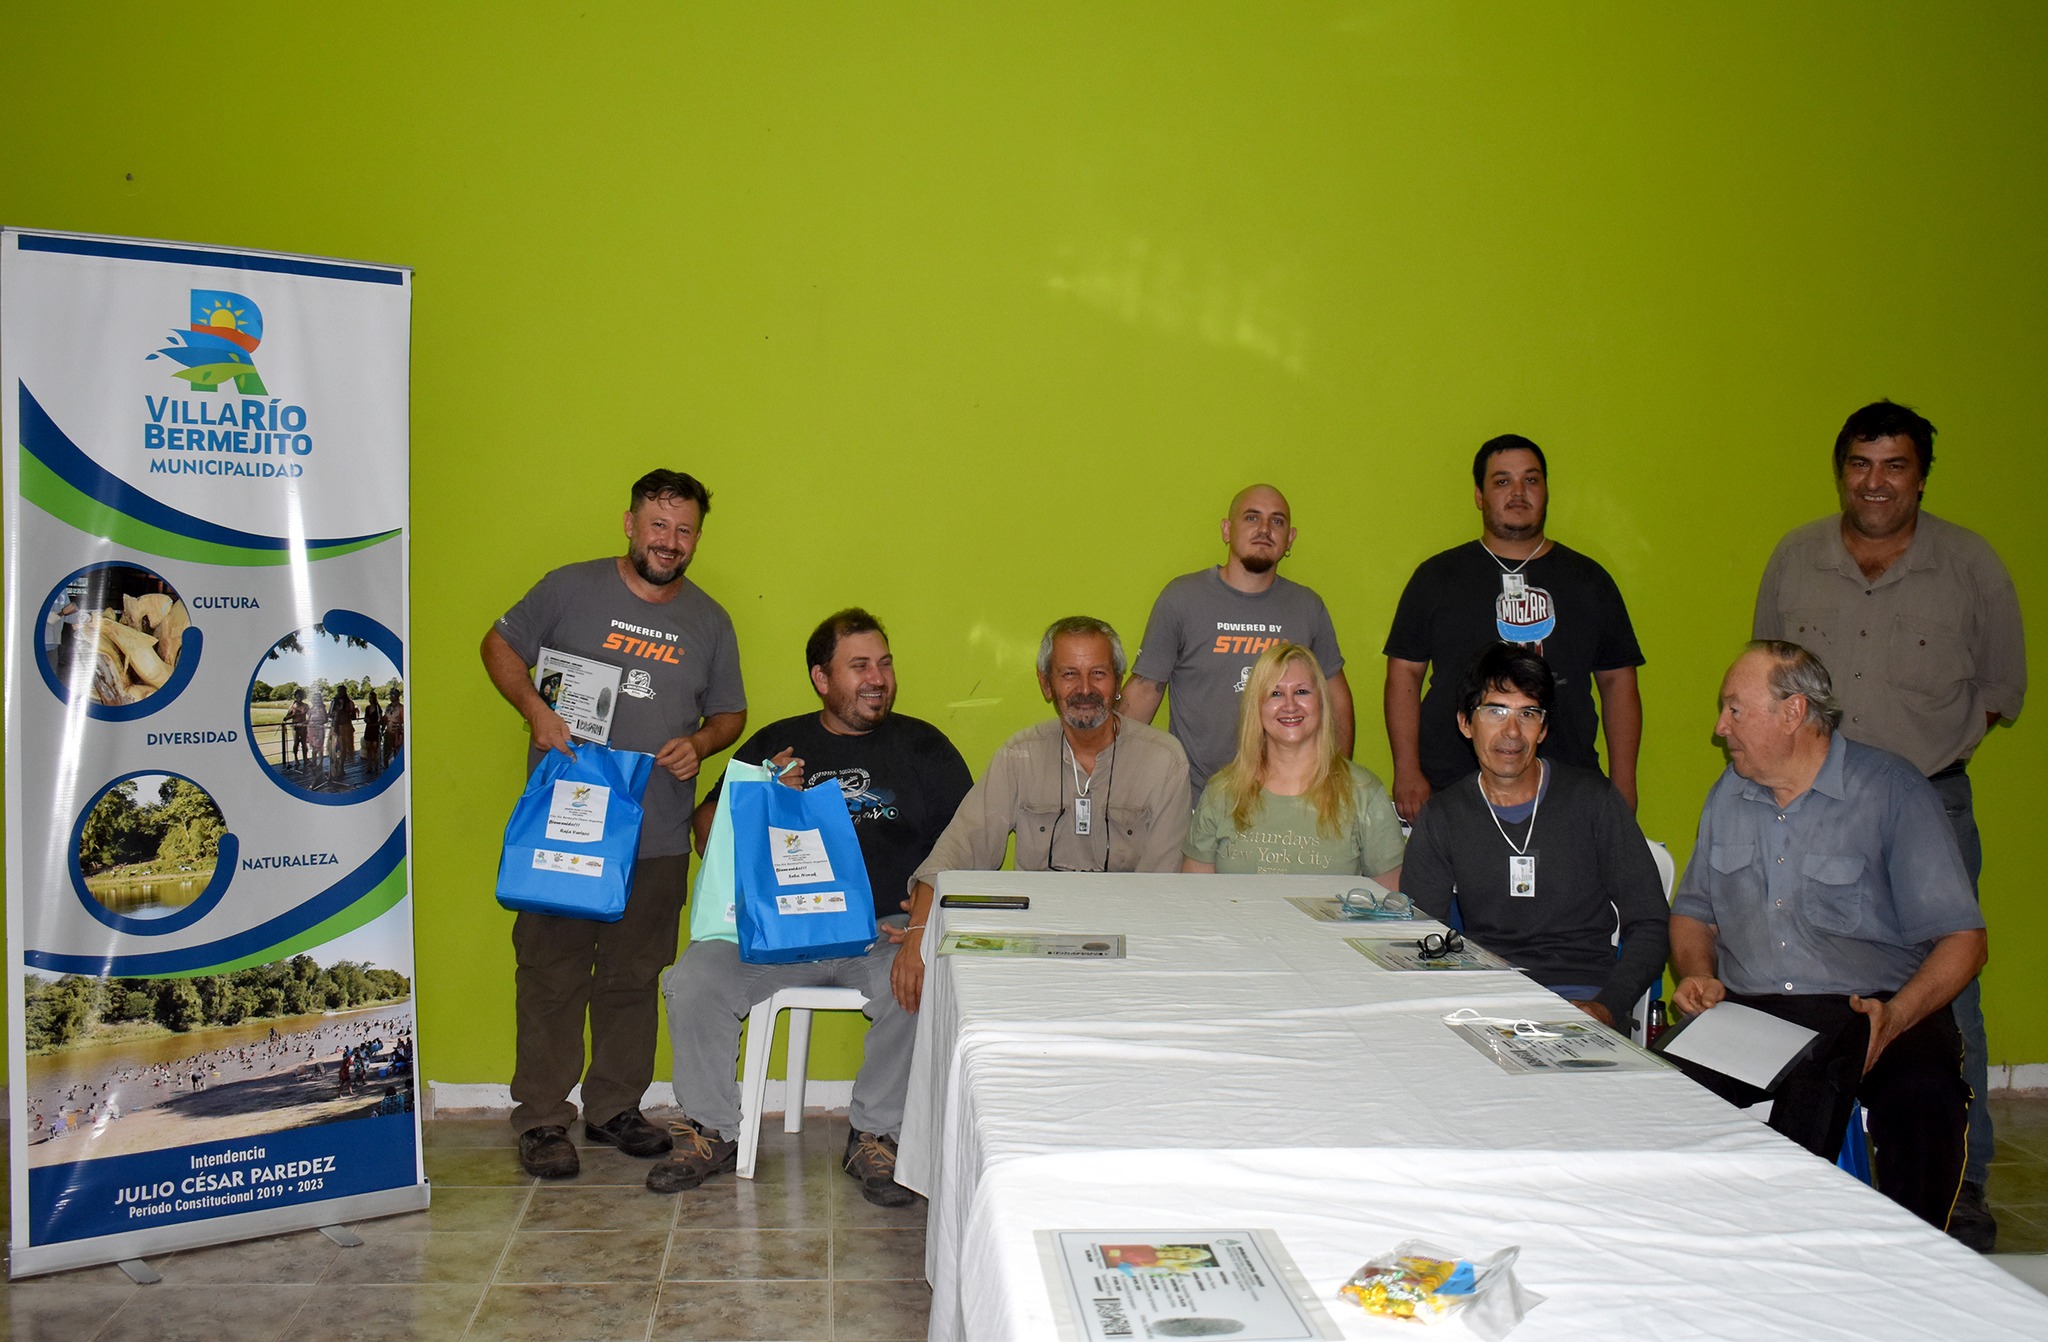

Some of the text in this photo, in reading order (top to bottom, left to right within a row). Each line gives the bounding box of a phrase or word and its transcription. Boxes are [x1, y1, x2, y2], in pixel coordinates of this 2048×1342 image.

[144, 423, 313, 456] BERMEJITO
[150, 458, 304, 478] MUNICIPALIDAD
[192, 596, 260, 609] CULTURA
[610, 619, 679, 642] POWERED BY
[1216, 622, 1282, 633] POWERED BY
[147, 730, 238, 746] DIVERSIDAD
[242, 853, 339, 871] NATURALEZA
[1256, 847, 1291, 863] York
[1297, 849, 1332, 869] City
[190, 1146, 266, 1170] Intendencia
[114, 1155, 336, 1205] JULIO CÉSAR PAREDEZ
[129, 1177, 324, 1218] Período Constitucional 2019 2023
